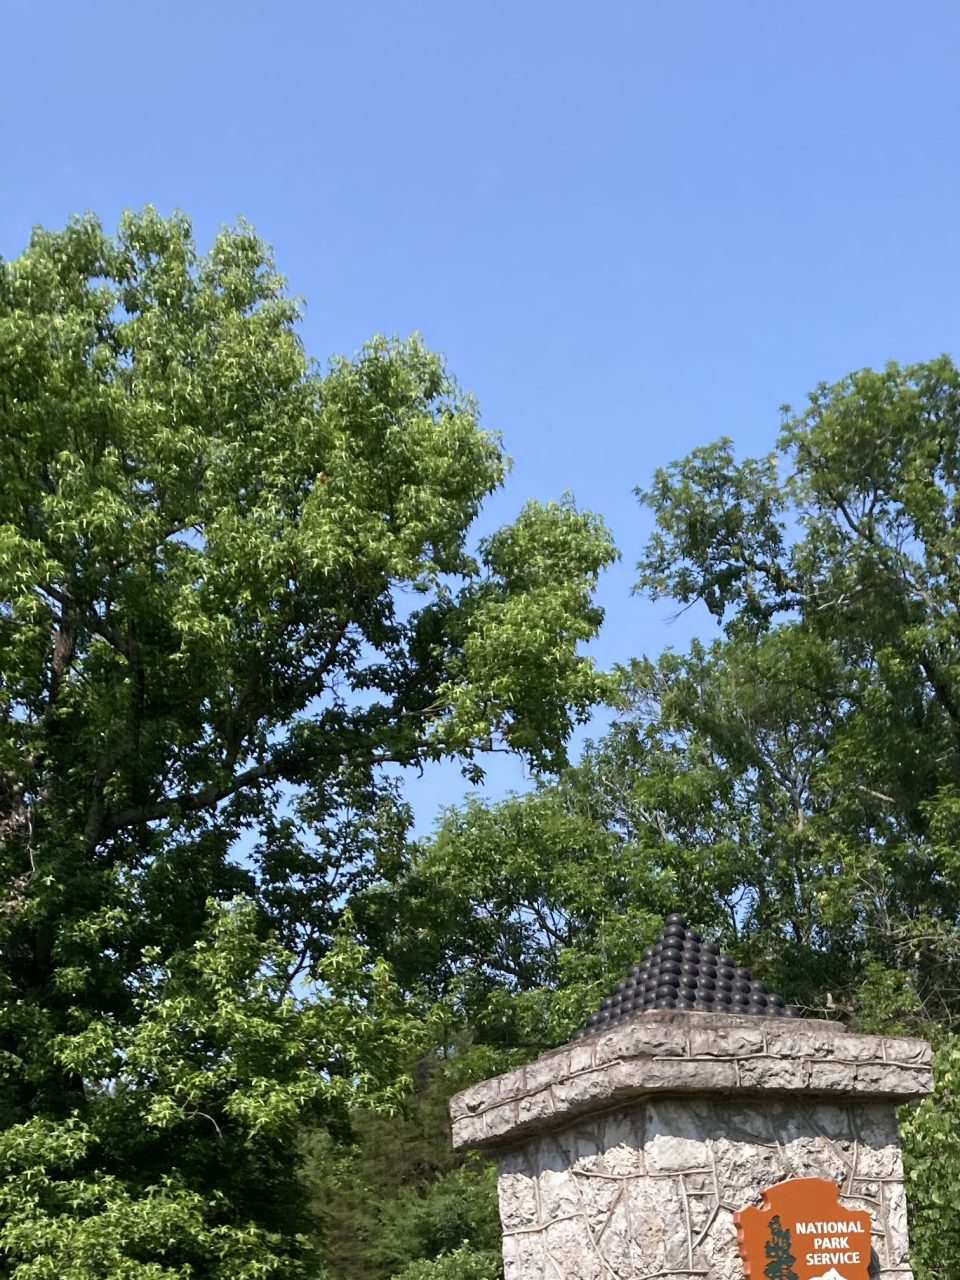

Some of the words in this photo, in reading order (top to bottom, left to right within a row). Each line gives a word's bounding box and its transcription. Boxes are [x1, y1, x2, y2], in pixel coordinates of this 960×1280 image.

[796, 1221, 864, 1234] NATIONAL
[814, 1236, 849, 1249] PARK
[806, 1252, 860, 1265] SERVICE
